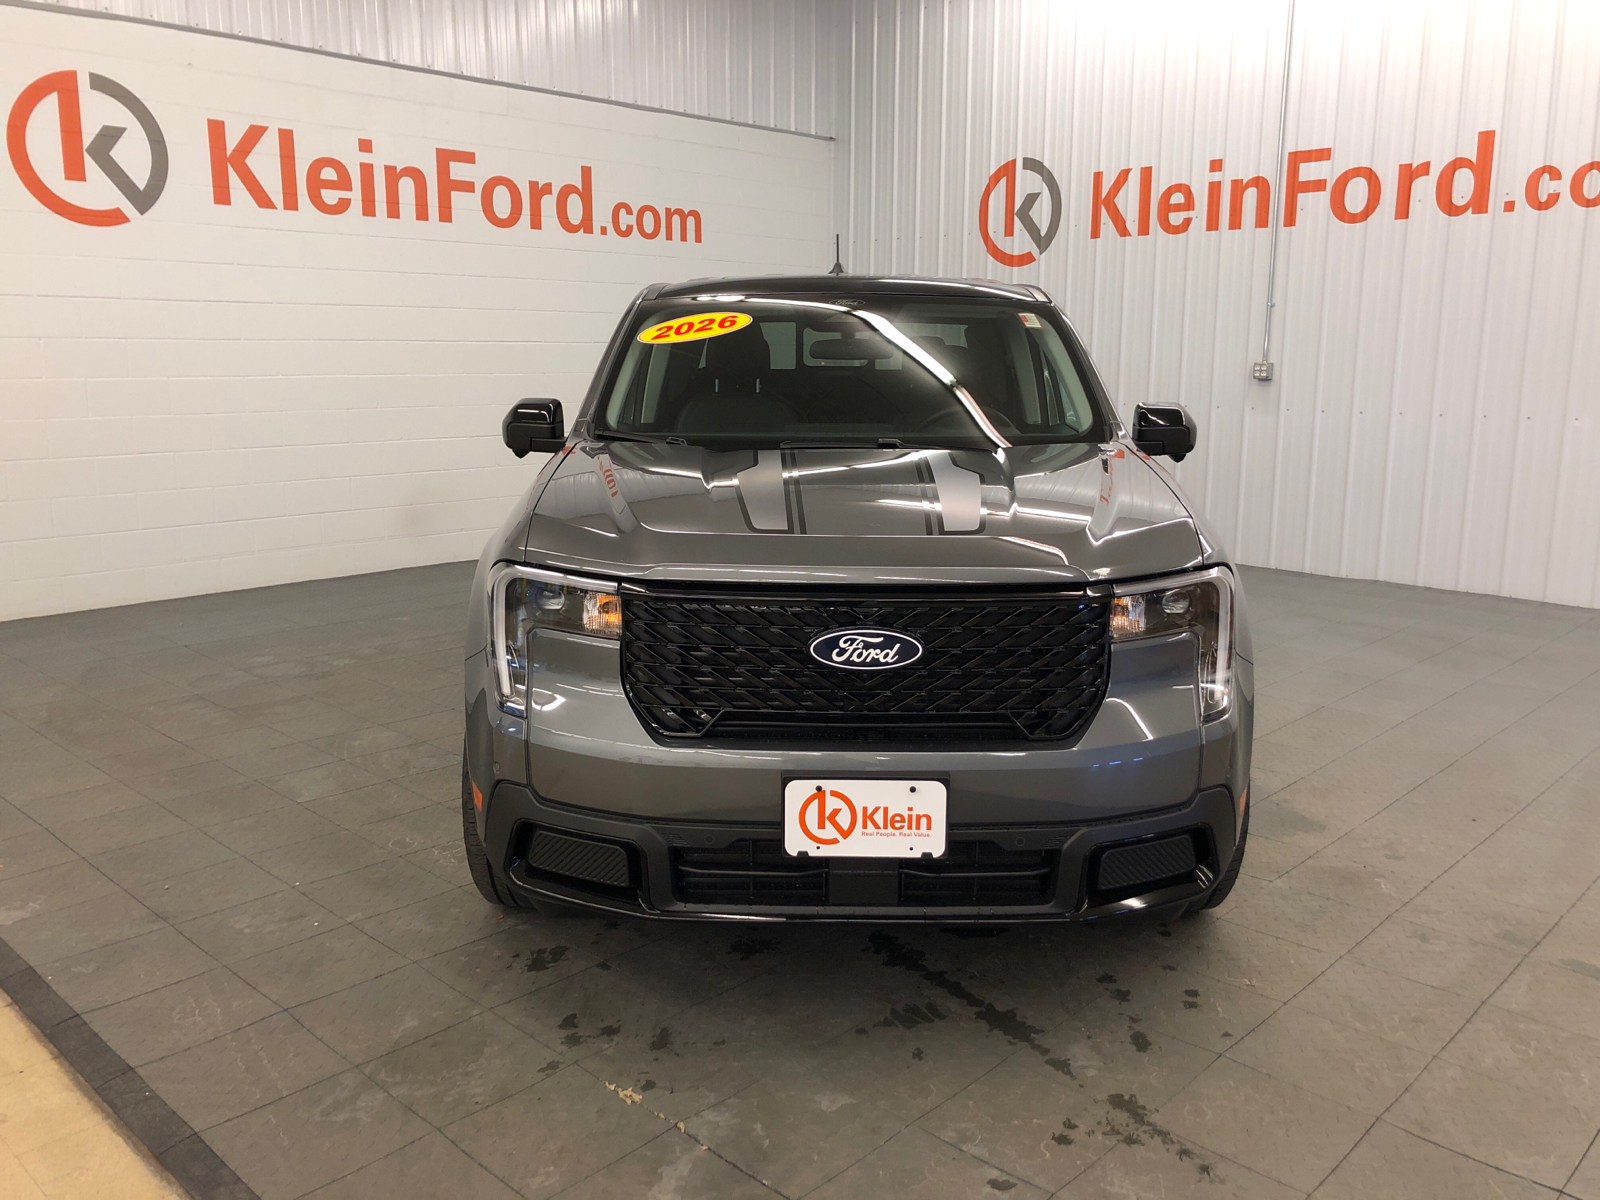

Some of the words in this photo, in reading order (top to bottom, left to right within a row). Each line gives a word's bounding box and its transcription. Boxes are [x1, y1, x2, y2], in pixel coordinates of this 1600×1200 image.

[207, 118, 702, 244] KleinFord.com
[651, 315, 740, 341] 2026
[831, 635, 901, 663] Ford
[861, 806, 933, 831] Klein
